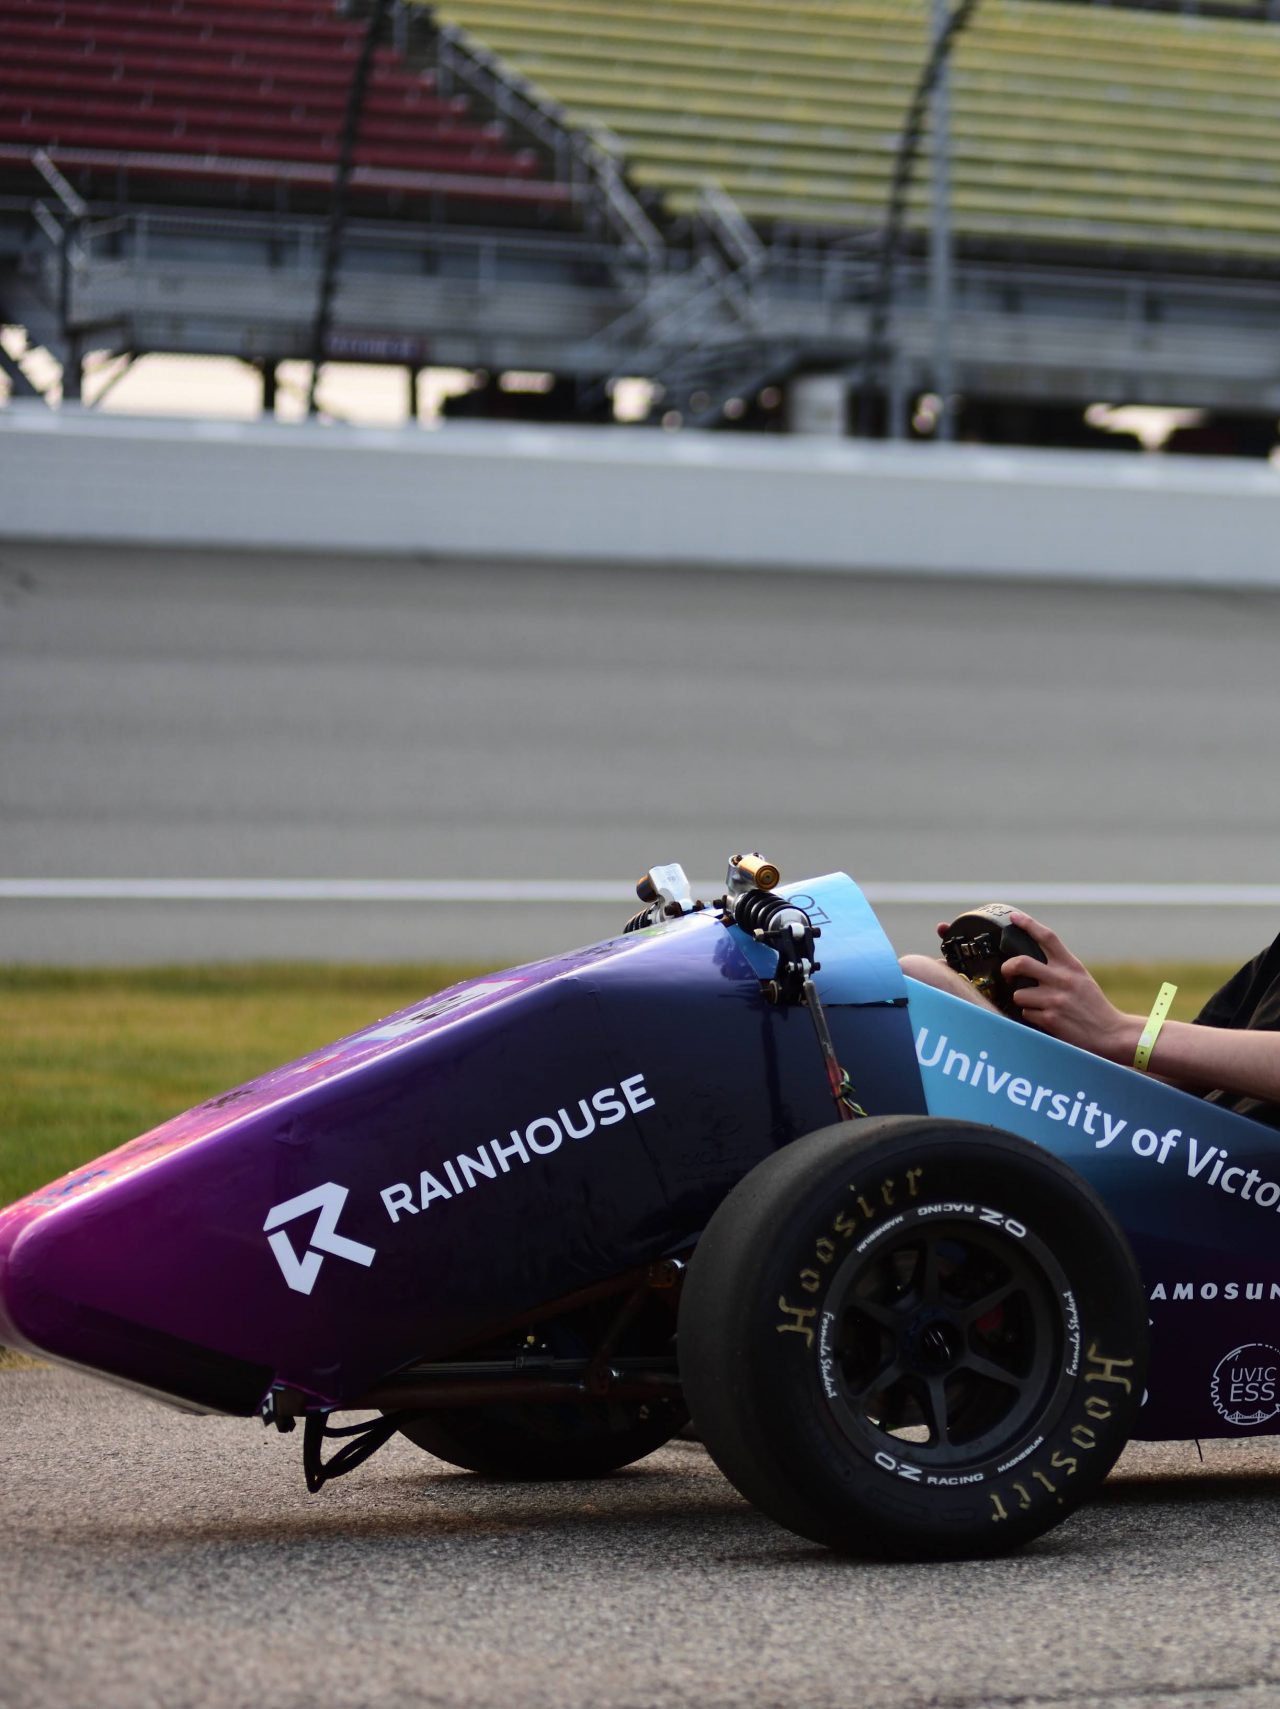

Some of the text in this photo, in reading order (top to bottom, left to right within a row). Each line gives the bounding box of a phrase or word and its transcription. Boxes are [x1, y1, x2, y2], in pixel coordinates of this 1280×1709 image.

[914, 1028, 1128, 1149] University
[1131, 1128, 1182, 1165] of
[379, 1073, 656, 1224] RAINHOUSE
[917, 1203, 974, 1216] RACING
[856, 1215, 904, 1253] MAGNESIUM
[775, 1168, 923, 1349] Hoosier
[820, 1311, 835, 1357] Formula
[1065, 1332, 1081, 1376] Formula
[1230, 1367, 1277, 1382] UVIC
[1230, 1382, 1276, 1402] ESS
[990, 1343, 1134, 1522] Hoosier
[998, 1436, 1045, 1473] MAGNESIUM
[927, 1473, 984, 1486] RACING
